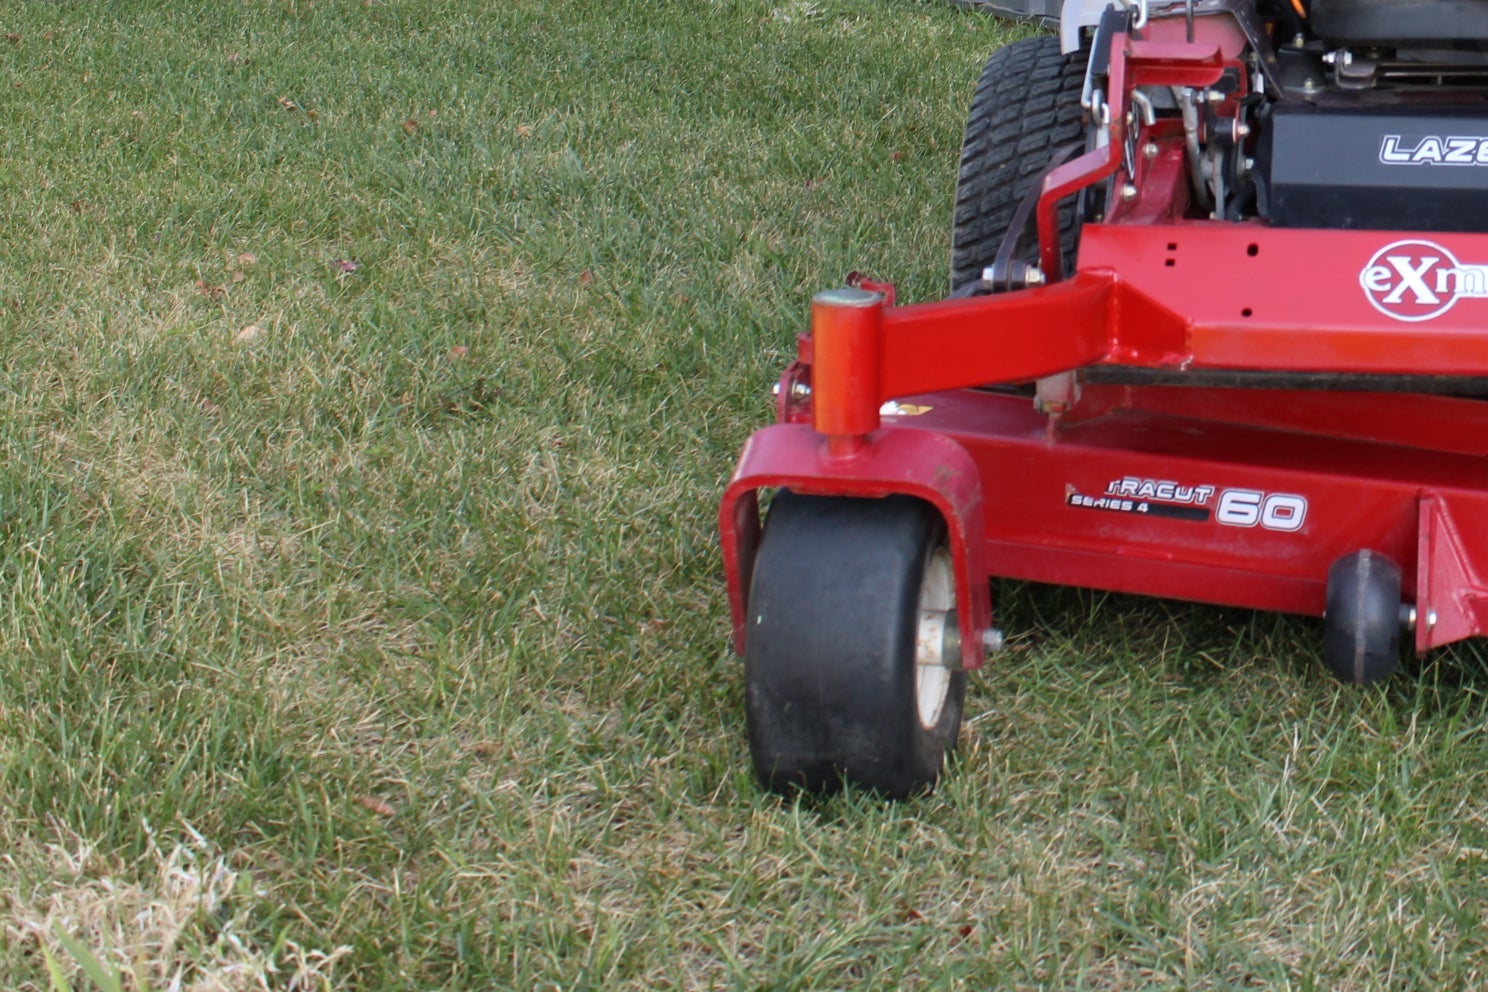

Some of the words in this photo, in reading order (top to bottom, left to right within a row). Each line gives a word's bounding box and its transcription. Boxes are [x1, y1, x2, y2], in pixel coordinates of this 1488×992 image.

[1071, 494, 1133, 511] SERIES
[1137, 503, 1149, 513] 4
[1216, 488, 1308, 532] 60
